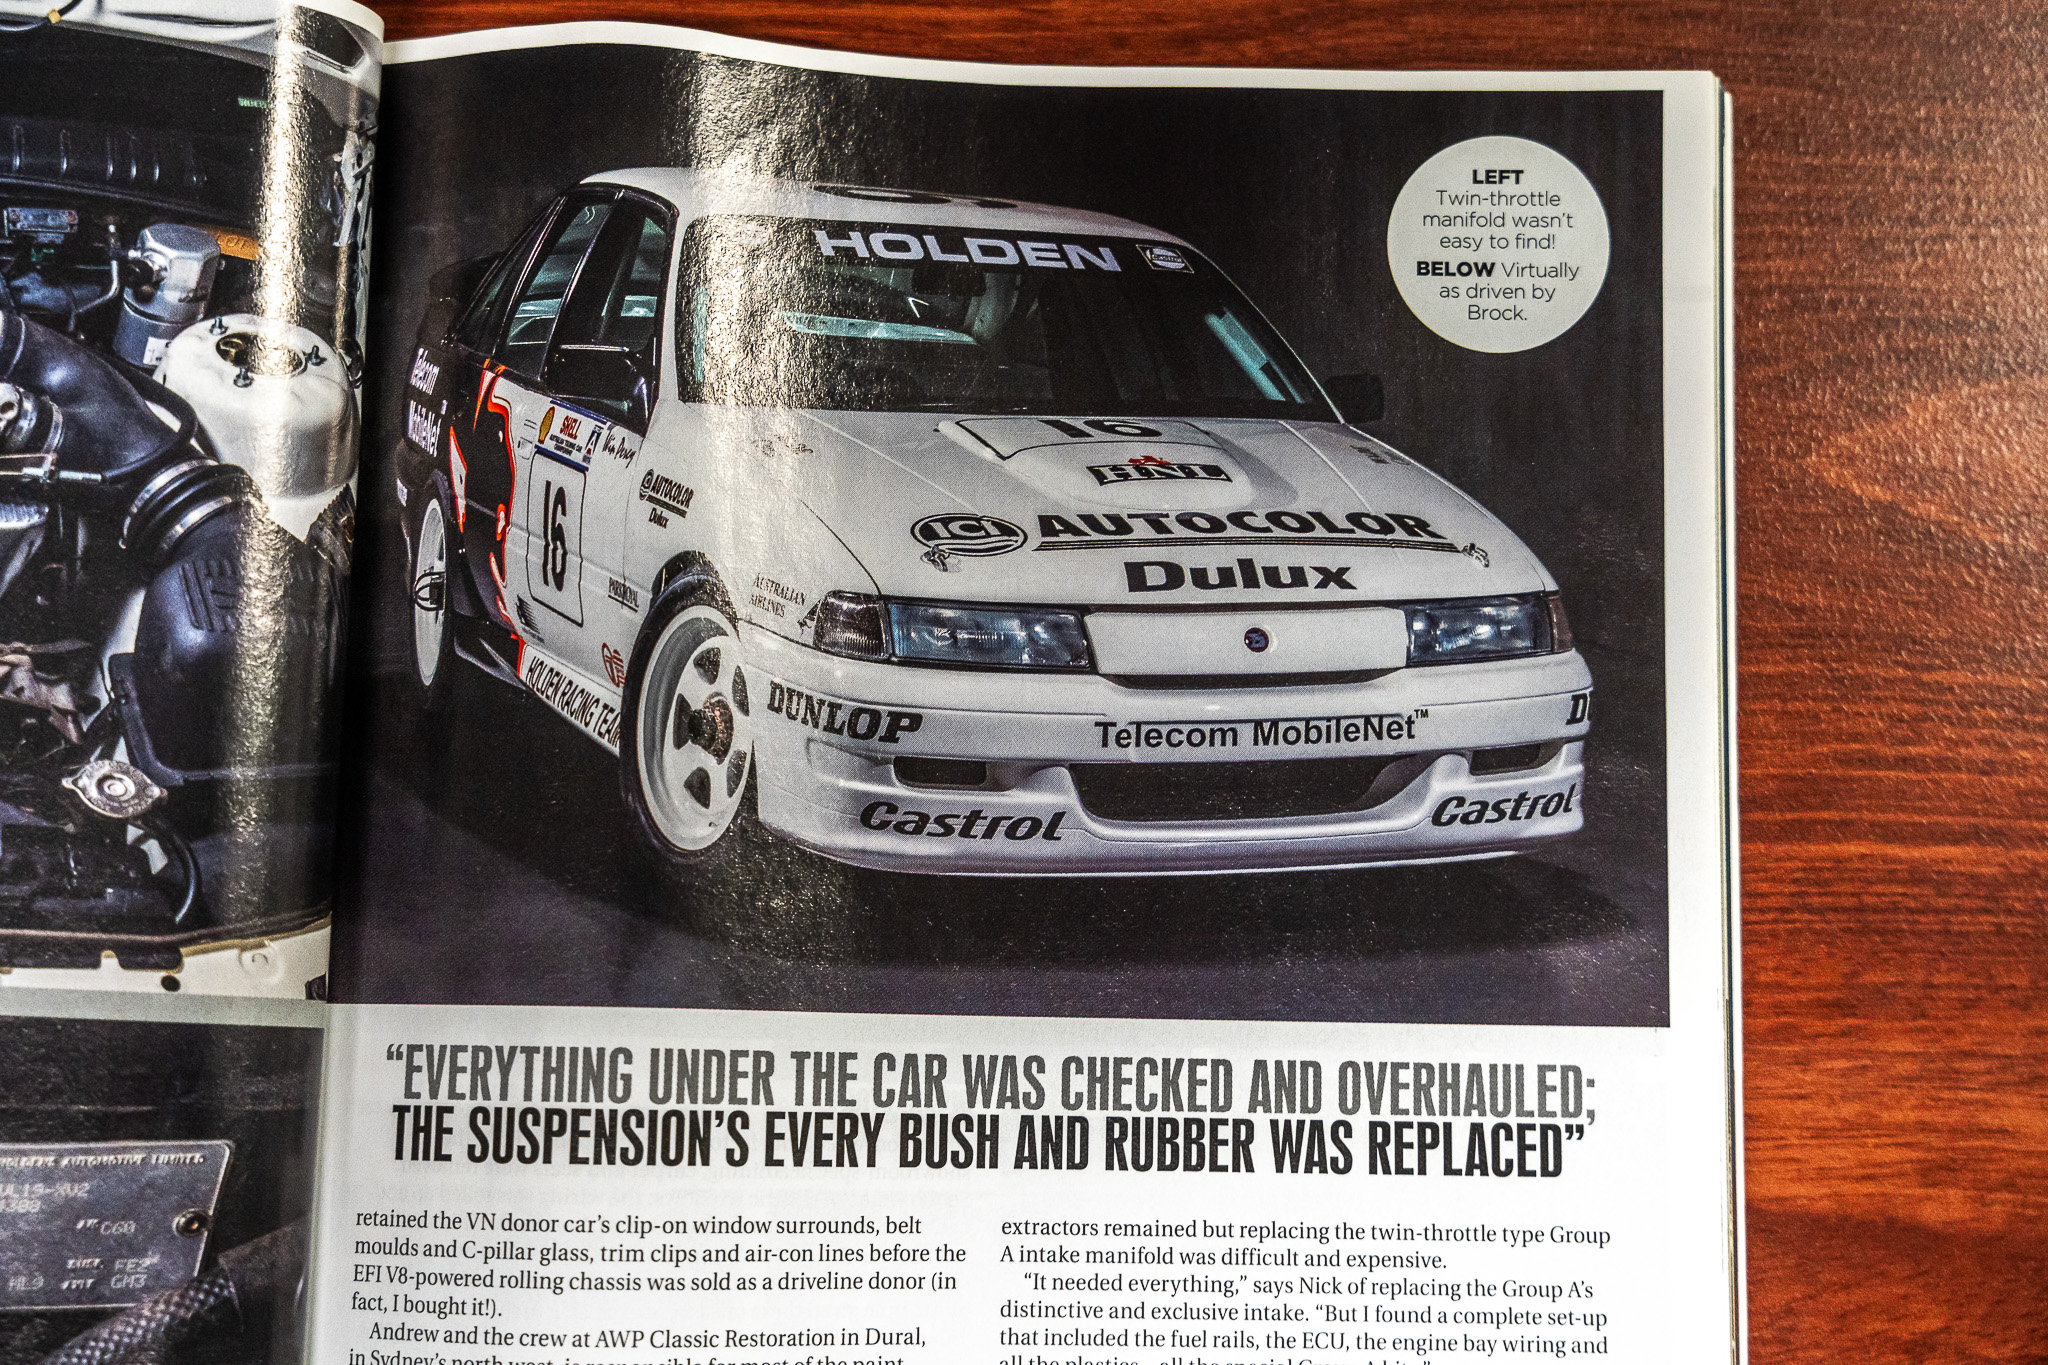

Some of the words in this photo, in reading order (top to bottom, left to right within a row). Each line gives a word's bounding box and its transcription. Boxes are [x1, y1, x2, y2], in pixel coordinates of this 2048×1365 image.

[1472, 168, 1525, 185] LEFT
[1435, 189, 1561, 207] Twin-throttle
[1422, 211, 1506, 228] manifold
[813, 230, 1122, 272] HOLDEN
[1439, 236, 1484, 253] easy
[1488, 233, 1510, 250] to
[1514, 233, 1555, 250] find!
[1416, 260, 1497, 278] BELOW
[1500, 261, 1580, 282] Virtually
[1439, 285, 1460, 299] as
[1465, 282, 1526, 300] driven
[1531, 283, 1556, 303] by
[1467, 304, 1528, 321] Brock.
[1037, 419, 1163, 438] 16
[650, 474, 695, 509] AUTOCOLOR
[542, 479, 569, 592] 16
[928, 519, 1002, 538] ICI
[1036, 510, 1448, 540] AUTOCOLOR
[752, 572, 808, 606] AUSTRALIAN
[1124, 557, 1358, 593] Dulux
[525, 655, 567, 705] HOLDEN
[556, 679, 601, 729] RACING
[766, 679, 924, 744] DUNLOP
[1094, 720, 1239, 748] Telecom
[859, 800, 1068, 841] Castrol
[1431, 782, 1577, 827] Castrol
[649, 1048, 774, 1105] UNDER
[791, 1051, 858, 1106] THE
[873, 1052, 947, 1108] CAR
[963, 1054, 1045, 1110] WAS
[1062, 1056, 1232, 1112] CHECKED
[1248, 1059, 1321, 1114] AND
[1339, 1061, 1595, 1125] OVERHAULED;
[392, 1105, 454, 1162] THE
[765, 1112, 885, 1167] EVERY
[900, 1113, 999, 1169] BUSH
[1014, 1115, 1089, 1170] AND
[1106, 1117, 1254, 1172] RUBBER
[1270, 1119, 1352, 1174] WAS
[355, 1208, 429, 1229] retained
[432, 1210, 463, 1230] the
[465, 1211, 497, 1231] VN
[500, 1212, 560, 1233] donor
[615, 1214, 688, 1240] clip-on
[692, 1215, 773, 1235] window
[776, 1215, 880, 1237] surrounds,
[885, 1215, 922, 1235] belt
[1001, 1219, 1099, 1237] extractors
[1104, 1219, 1198, 1238] remained
[1202, 1219, 1235, 1239] but
[1239, 1220, 1330, 1245] replacing
[1334, 1221, 1366, 1241] the
[1370, 1222, 1497, 1243] twin-throttle
[1502, 1227, 1545, 1248] type
[1549, 1225, 1611, 1249] Group
[354, 1236, 419, 1257] moulds
[422, 1238, 458, 1259] and
[462, 1240, 536, 1265] C-pillar
[539, 1241, 594, 1267] glass,
[600, 1243, 645, 1263] trim
[650, 1243, 697, 1268] clips
[702, 1243, 740, 1263] and
[744, 1244, 814, 1263] air-con
[818, 1243, 864, 1262] lines
[869, 1243, 930, 1262] before
[935, 1243, 967, 1262] the
[999, 1245, 1015, 1263] A
[1019, 1244, 1080, 1264] intake
[1085, 1245, 1174, 1265] manifold
[1179, 1251, 1216, 1266] was
[1221, 1247, 1299, 1267] difficult
[1304, 1248, 1341, 1267] and
[1346, 1250, 1447, 1273] expensive.
[352, 1263, 383, 1284] EFI
[385, 1265, 495, 1291] V8-powered
[498, 1269, 565, 1296] rolling
[568, 1271, 642, 1291] chassis
[646, 1277, 686, 1291] was
[690, 1271, 731, 1291] sold
[736, 1276, 757, 1291] as
[762, 1276, 773, 1291] a
[777, 1271, 864, 1291] driveline
[868, 1271, 926, 1290] donor
[931, 1271, 957, 1292] (in
[1051, 1272, 1123, 1292] needed
[1253, 1280, 1294, 1299] says
[1299, 1276, 1343, 1295] Nick
[1347, 1276, 1368, 1295] of
[1371, 1277, 1462, 1302] replacing
[1466, 1278, 1497, 1297] the
[1502, 1279, 1563, 1303] Group
[351, 1290, 388, 1315] fact,
[392, 1293, 400, 1313] I
[403, 1293, 468, 1320] bought
[471, 1297, 502, 1320] it!).
[1000, 1299, 1104, 1319] distinctive
[1108, 1301, 1145, 1320] and
[1151, 1301, 1239, 1321] exclusive
[1244, 1302, 1309, 1322] intake.
[1363, 1305, 1369, 1323] I
[1375, 1304, 1432, 1324] found
[1437, 1310, 1448, 1324] a
[1453, 1306, 1543, 1330] complete
[1547, 1310, 1608, 1332] set-up
[368, 1321, 441, 1343] Andrew
[443, 1325, 479, 1345] and
[483, 1326, 515, 1347] the
[518, 1332, 568, 1348] crew
[571, 1332, 591, 1348] at
[594, 1329, 645, 1349] AWP
[649, 1329, 720, 1349] Classic
[724, 1328, 836, 1348] Restoration
[840, 1327, 860, 1346] in
[864, 1326, 926, 1348] Dural,
[999, 1326, 1039, 1346] that
[1043, 1327, 1129, 1347] included
[1134, 1328, 1166, 1348] the
[1171, 1329, 1207, 1348] fuel
[1213, 1330, 1260, 1351] rails,
[1265, 1330, 1297, 1349] the
[1302, 1331, 1350, 1352] ECU,
[1356, 1331, 1387, 1351] the
[1392, 1333, 1458, 1357] engine
[1463, 1333, 1498, 1358] bay
[1502, 1335, 1567, 1359] wiring
[1571, 1335, 1608, 1354] and
